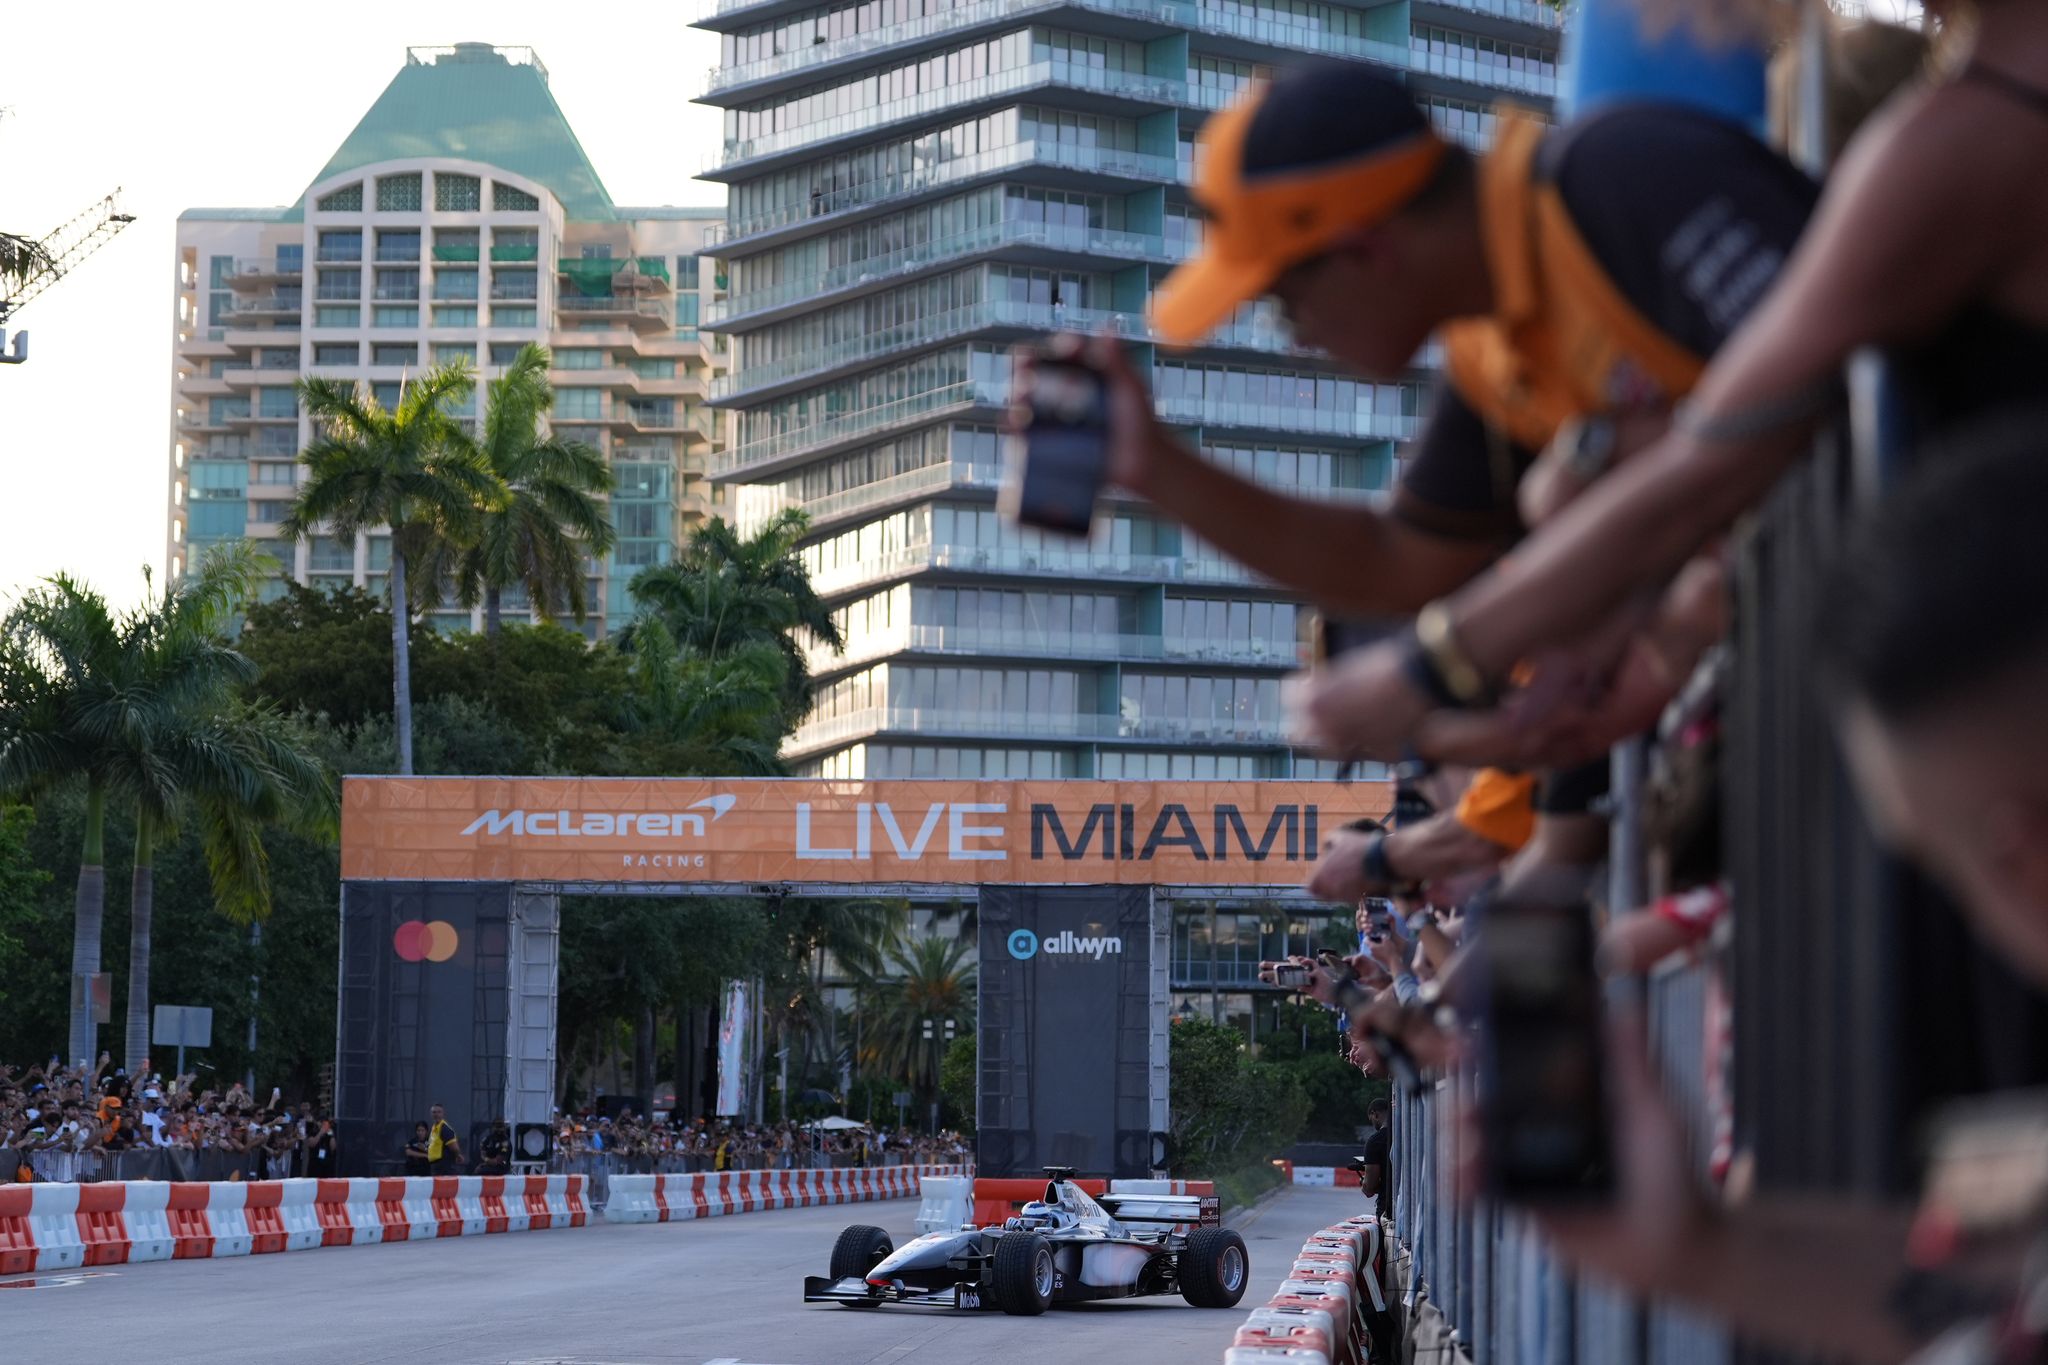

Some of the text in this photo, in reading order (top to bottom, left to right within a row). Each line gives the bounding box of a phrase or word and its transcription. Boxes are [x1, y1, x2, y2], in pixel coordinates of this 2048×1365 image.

[459, 809, 705, 837] McLaren
[795, 802, 1318, 862] LIVE MIAMI
[623, 855, 705, 868] RACING
[1043, 930, 1122, 961] allwyn
